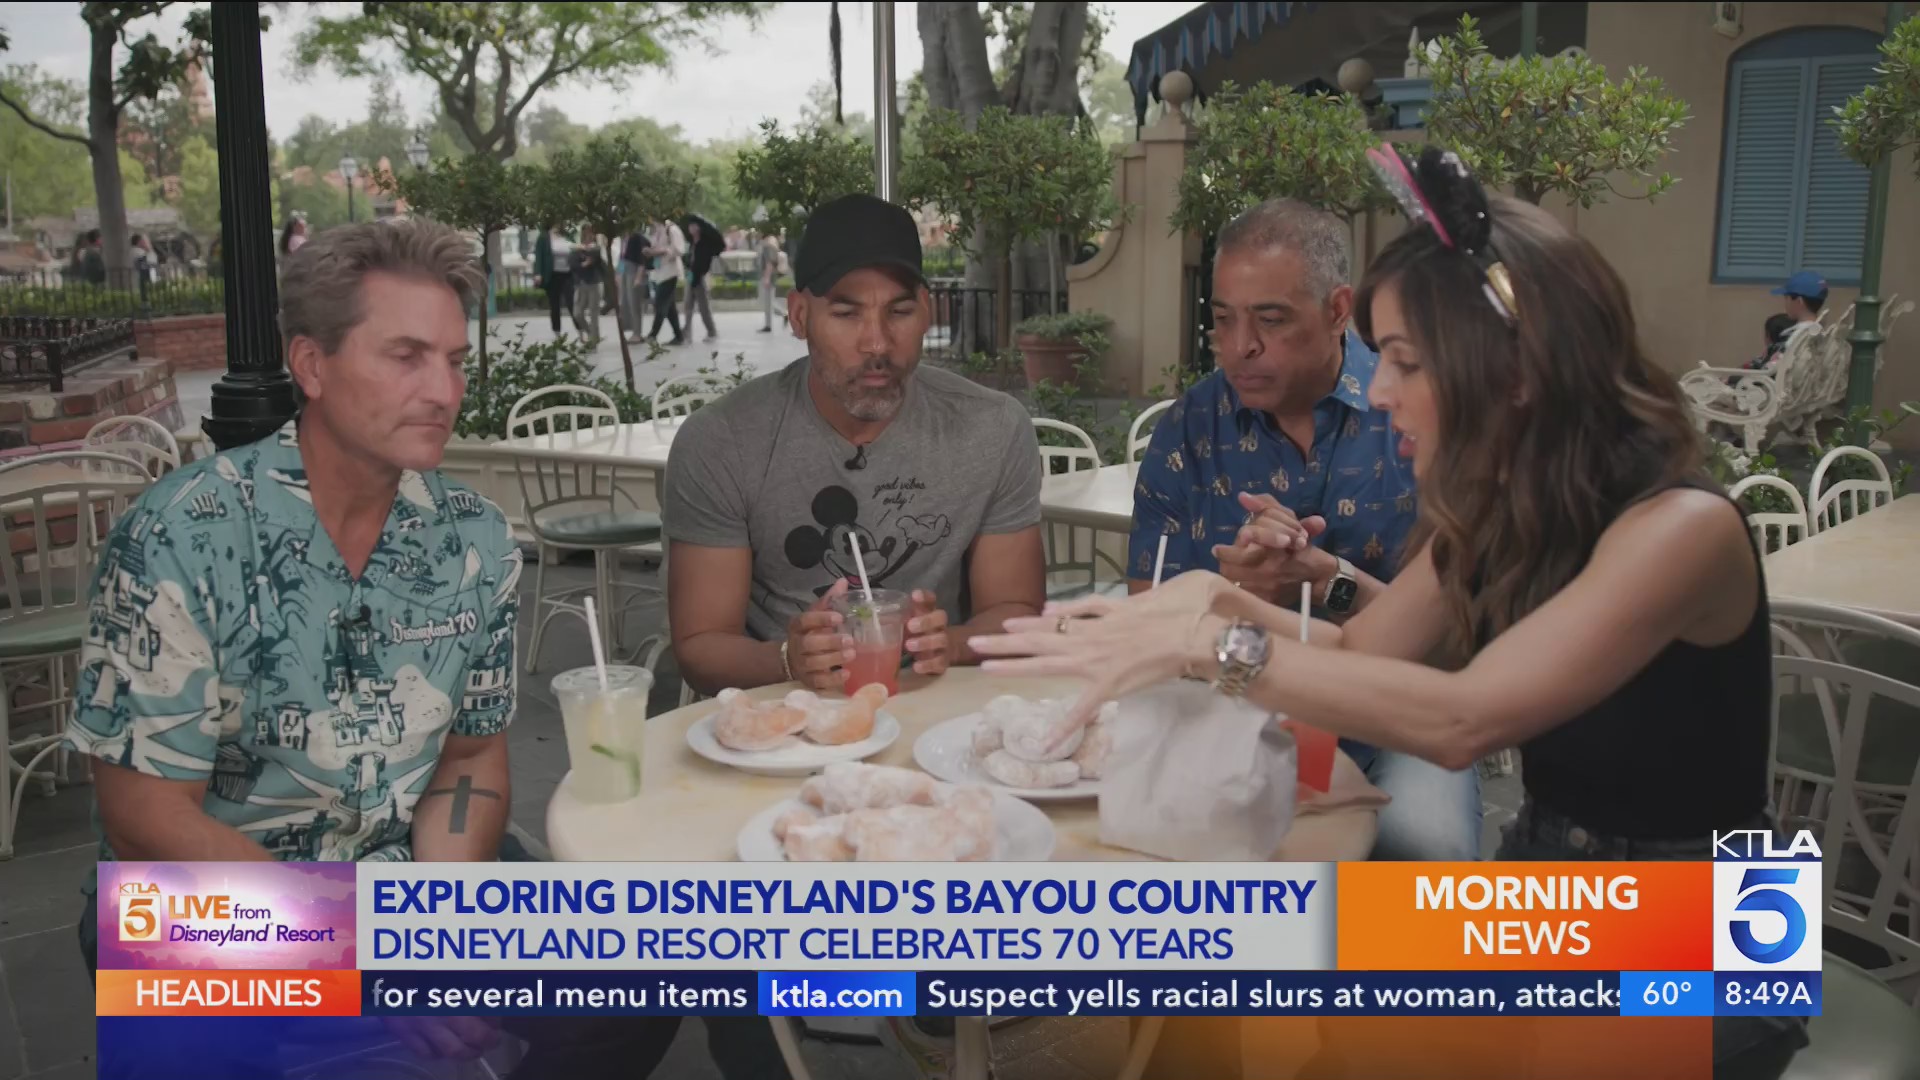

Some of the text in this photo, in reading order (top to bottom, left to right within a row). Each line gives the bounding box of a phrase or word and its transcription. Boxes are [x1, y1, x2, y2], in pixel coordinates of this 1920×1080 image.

[872, 476, 925, 499] good vibes
[390, 610, 476, 646] Disneyland 70
